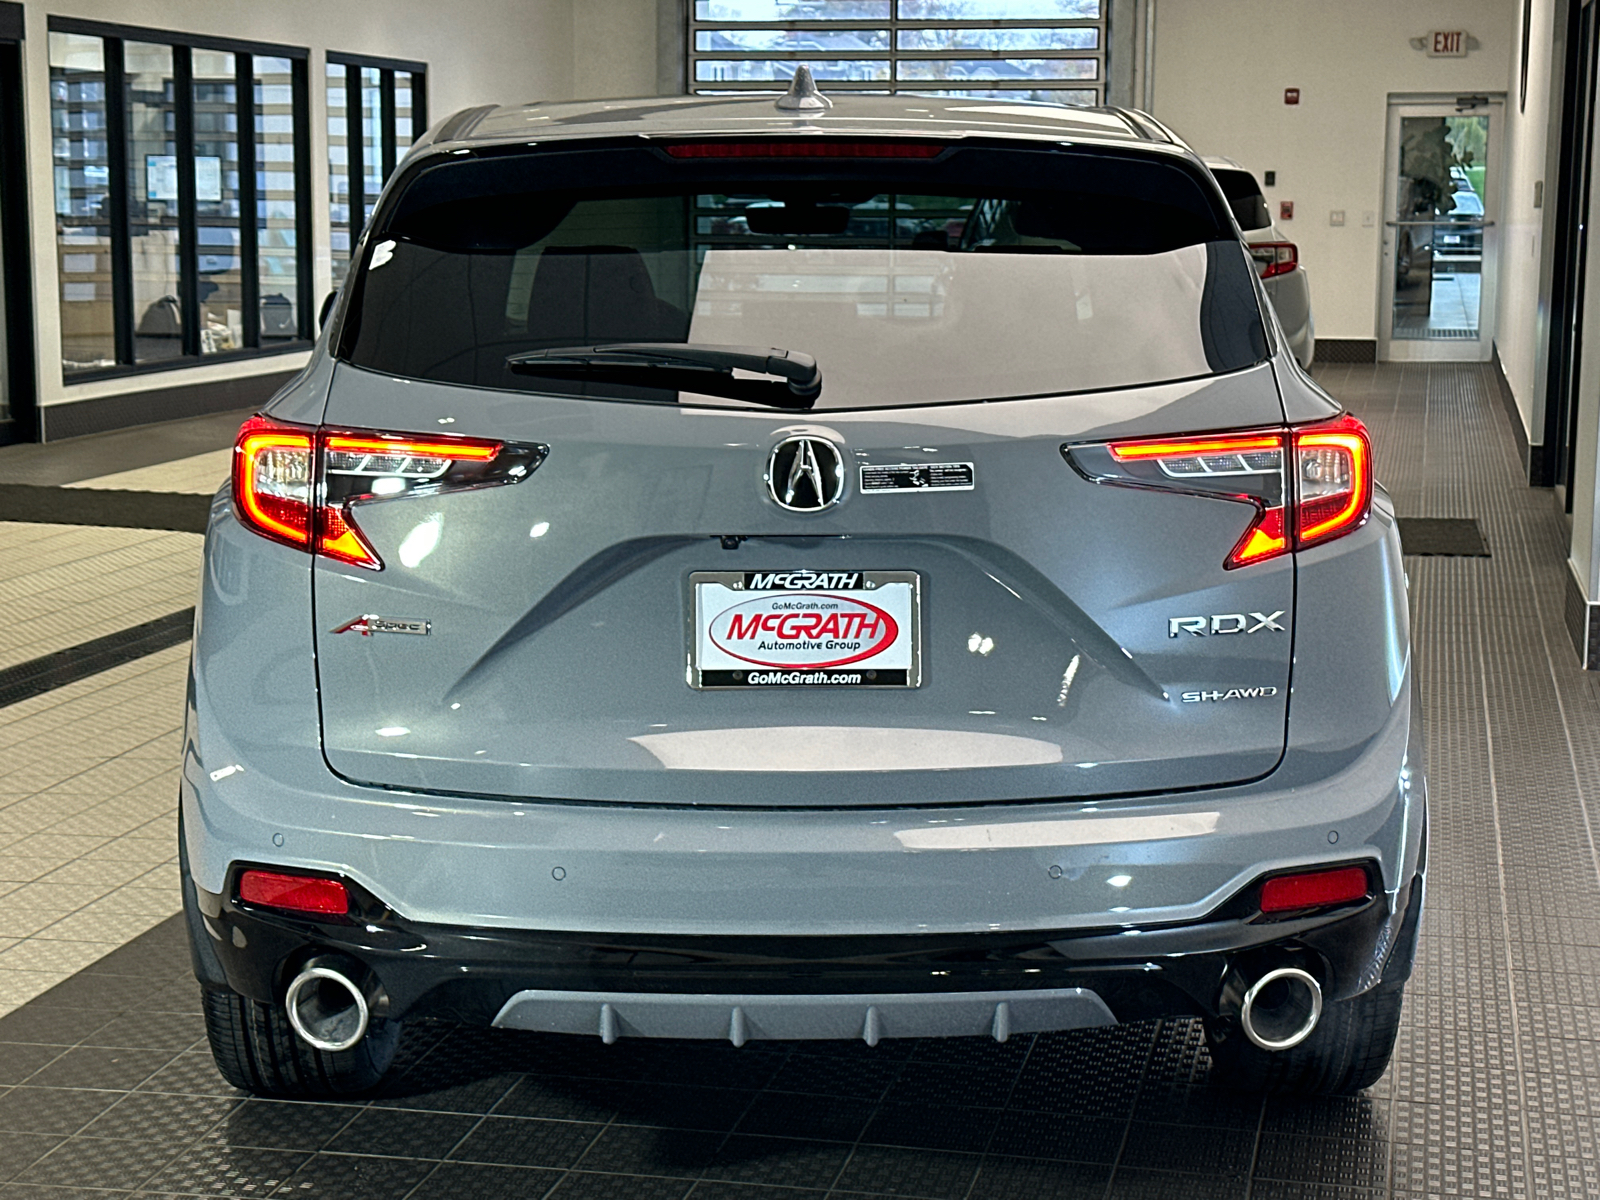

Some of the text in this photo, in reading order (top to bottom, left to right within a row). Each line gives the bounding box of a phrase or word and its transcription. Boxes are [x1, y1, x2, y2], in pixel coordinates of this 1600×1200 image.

[1433, 32, 1461, 53] EXIT
[771, 602, 838, 610] GoMcGrath.com
[1168, 610, 1286, 638] RDX
[758, 640, 861, 652] Automotive Group
[748, 672, 861, 685] GoMcGrath.com
[1181, 686, 1277, 703] SH-AWD
